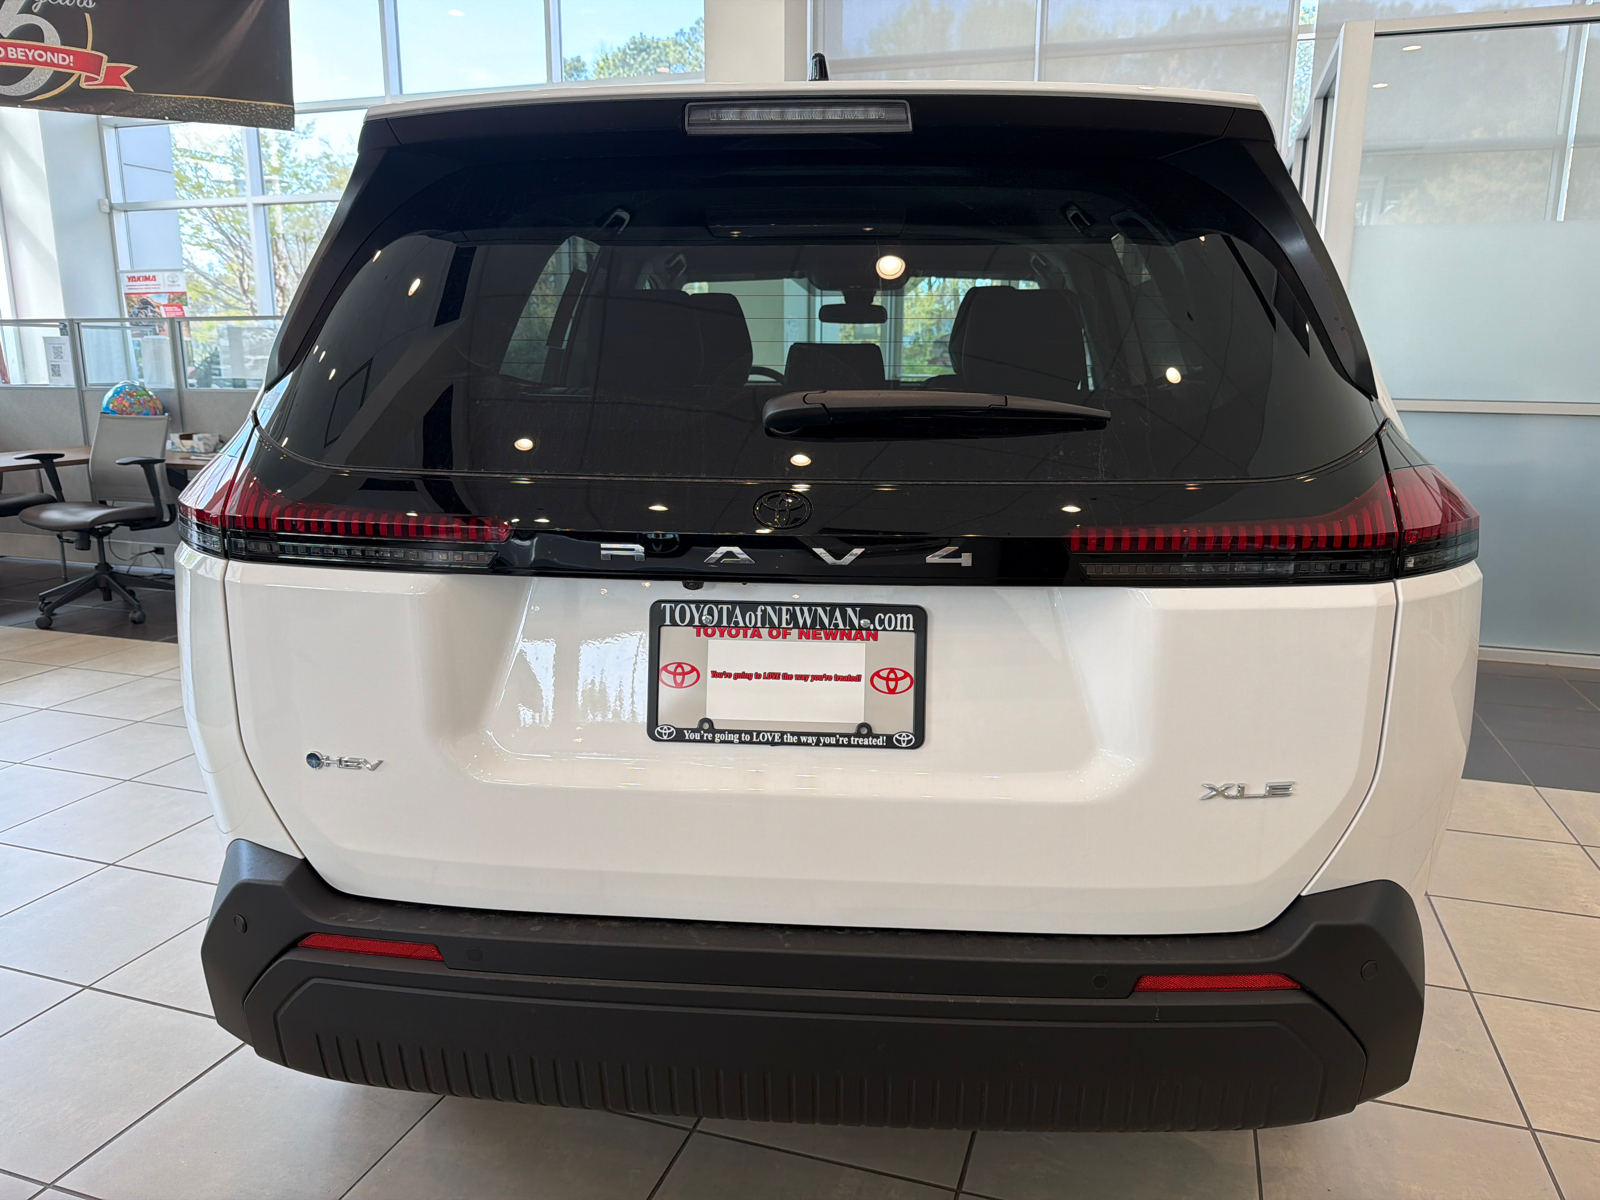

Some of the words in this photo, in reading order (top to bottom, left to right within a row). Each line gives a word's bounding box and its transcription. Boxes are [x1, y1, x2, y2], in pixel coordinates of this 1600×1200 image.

[7, 47, 74, 67] BEYOND!
[126, 275, 157, 283] YAKIMA
[600, 543, 973, 567] RAV4
[692, 626, 762, 639] TOYOTA
[768, 628, 793, 640] OF
[798, 628, 879, 642] NEWNAN
[710, 670, 732, 679] You're
[733, 671, 754, 681] going
[754, 671, 762, 680] to
[763, 672, 781, 680] LOVE
[781, 672, 794, 680] the
[794, 674, 810, 682] way
[810, 673, 833, 683] you're
[833, 673, 862, 682] treated!
[683, 729, 713, 741] You're
[714, 731, 740, 743] going
[741, 732, 751, 742] to
[752, 732, 782, 743] LOVE
[783, 733, 798, 743] the
[800, 736, 818, 746] way
[819, 734, 849, 746] you're
[850, 734, 887, 746] treated!
[1199, 780, 1297, 801] XLE
